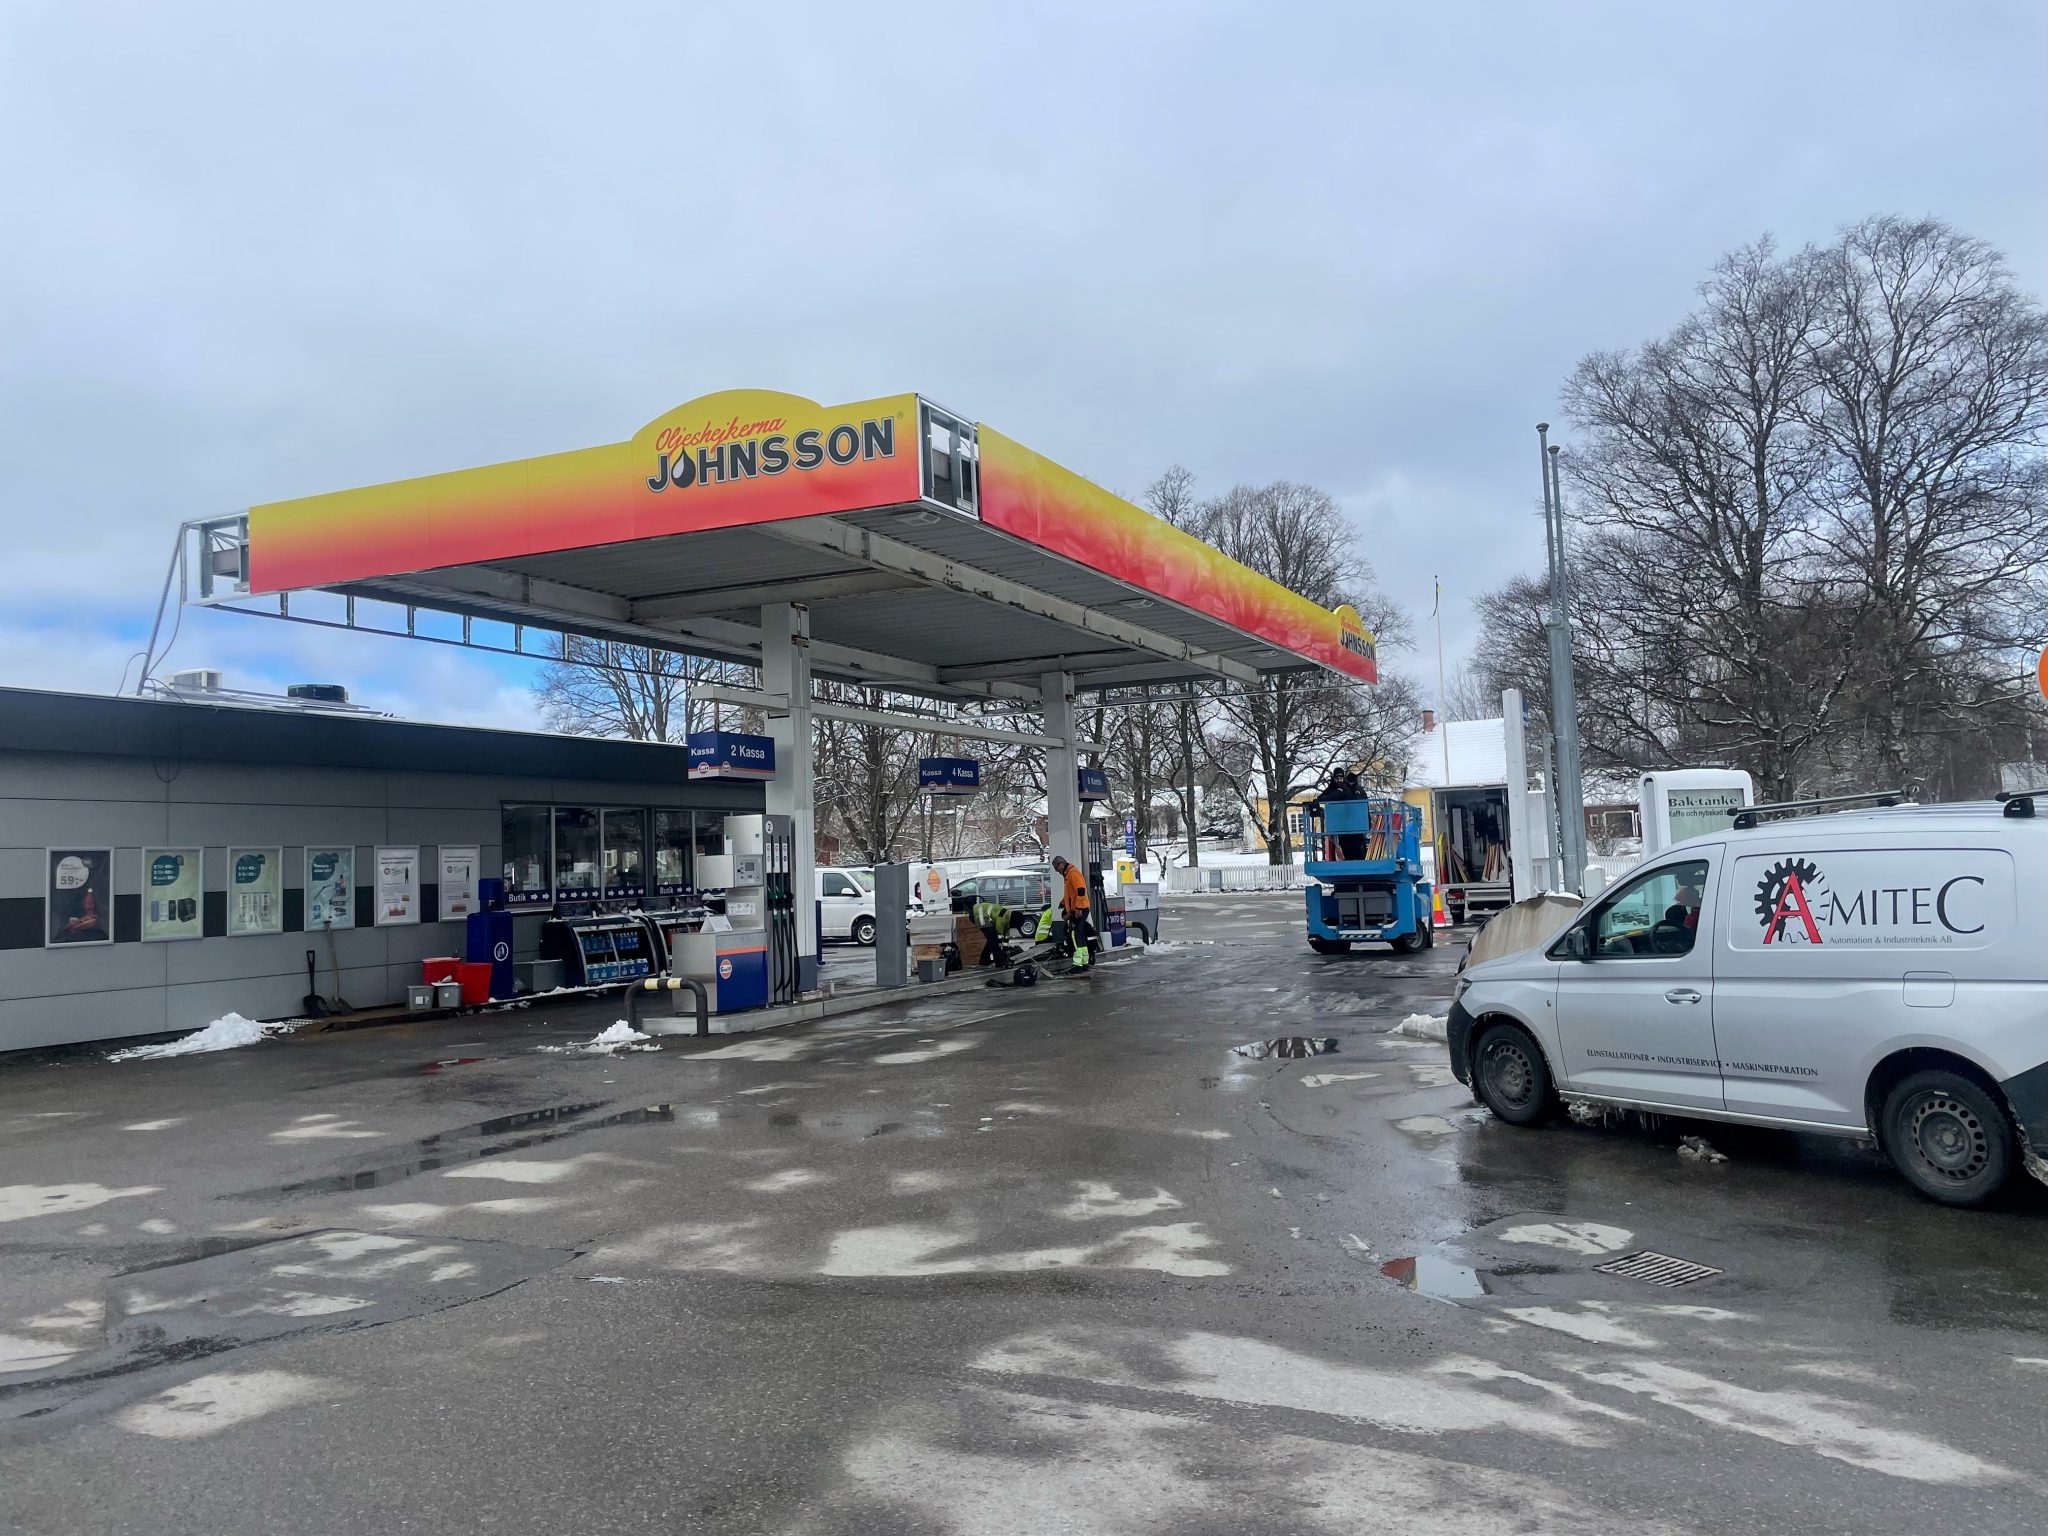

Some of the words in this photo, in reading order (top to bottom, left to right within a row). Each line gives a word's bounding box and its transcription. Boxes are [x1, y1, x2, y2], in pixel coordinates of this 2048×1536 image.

[655, 416, 787, 457] Oljeshejkerna
[646, 416, 896, 493] JOHNSSON
[1341, 628, 1375, 660] JOHNSSON
[691, 747, 714, 756] Kassa
[730, 744, 736, 756] 2
[739, 745, 764, 758] Kassa
[952, 767, 957, 777] 4
[957, 767, 974, 778] Kassa
[1668, 796, 1738, 807] Bak-tanke
[1698, 809, 1723, 818] nybakad
[659, 886, 674, 895] Butik
[508, 893, 527, 902] Butik
[1829, 936, 1873, 944] Automation
[1875, 936, 1881, 944] &
[1883, 935, 1938, 944] Industriteknik
[1939, 935, 1953, 944] AB
[1586, 1049, 1650, 1062] ELINSTALLATIONER
[1657, 1055, 1723, 1069] INDUSTRISERVICE
[1732, 1061, 1818, 1076] MASKINREPARATION
